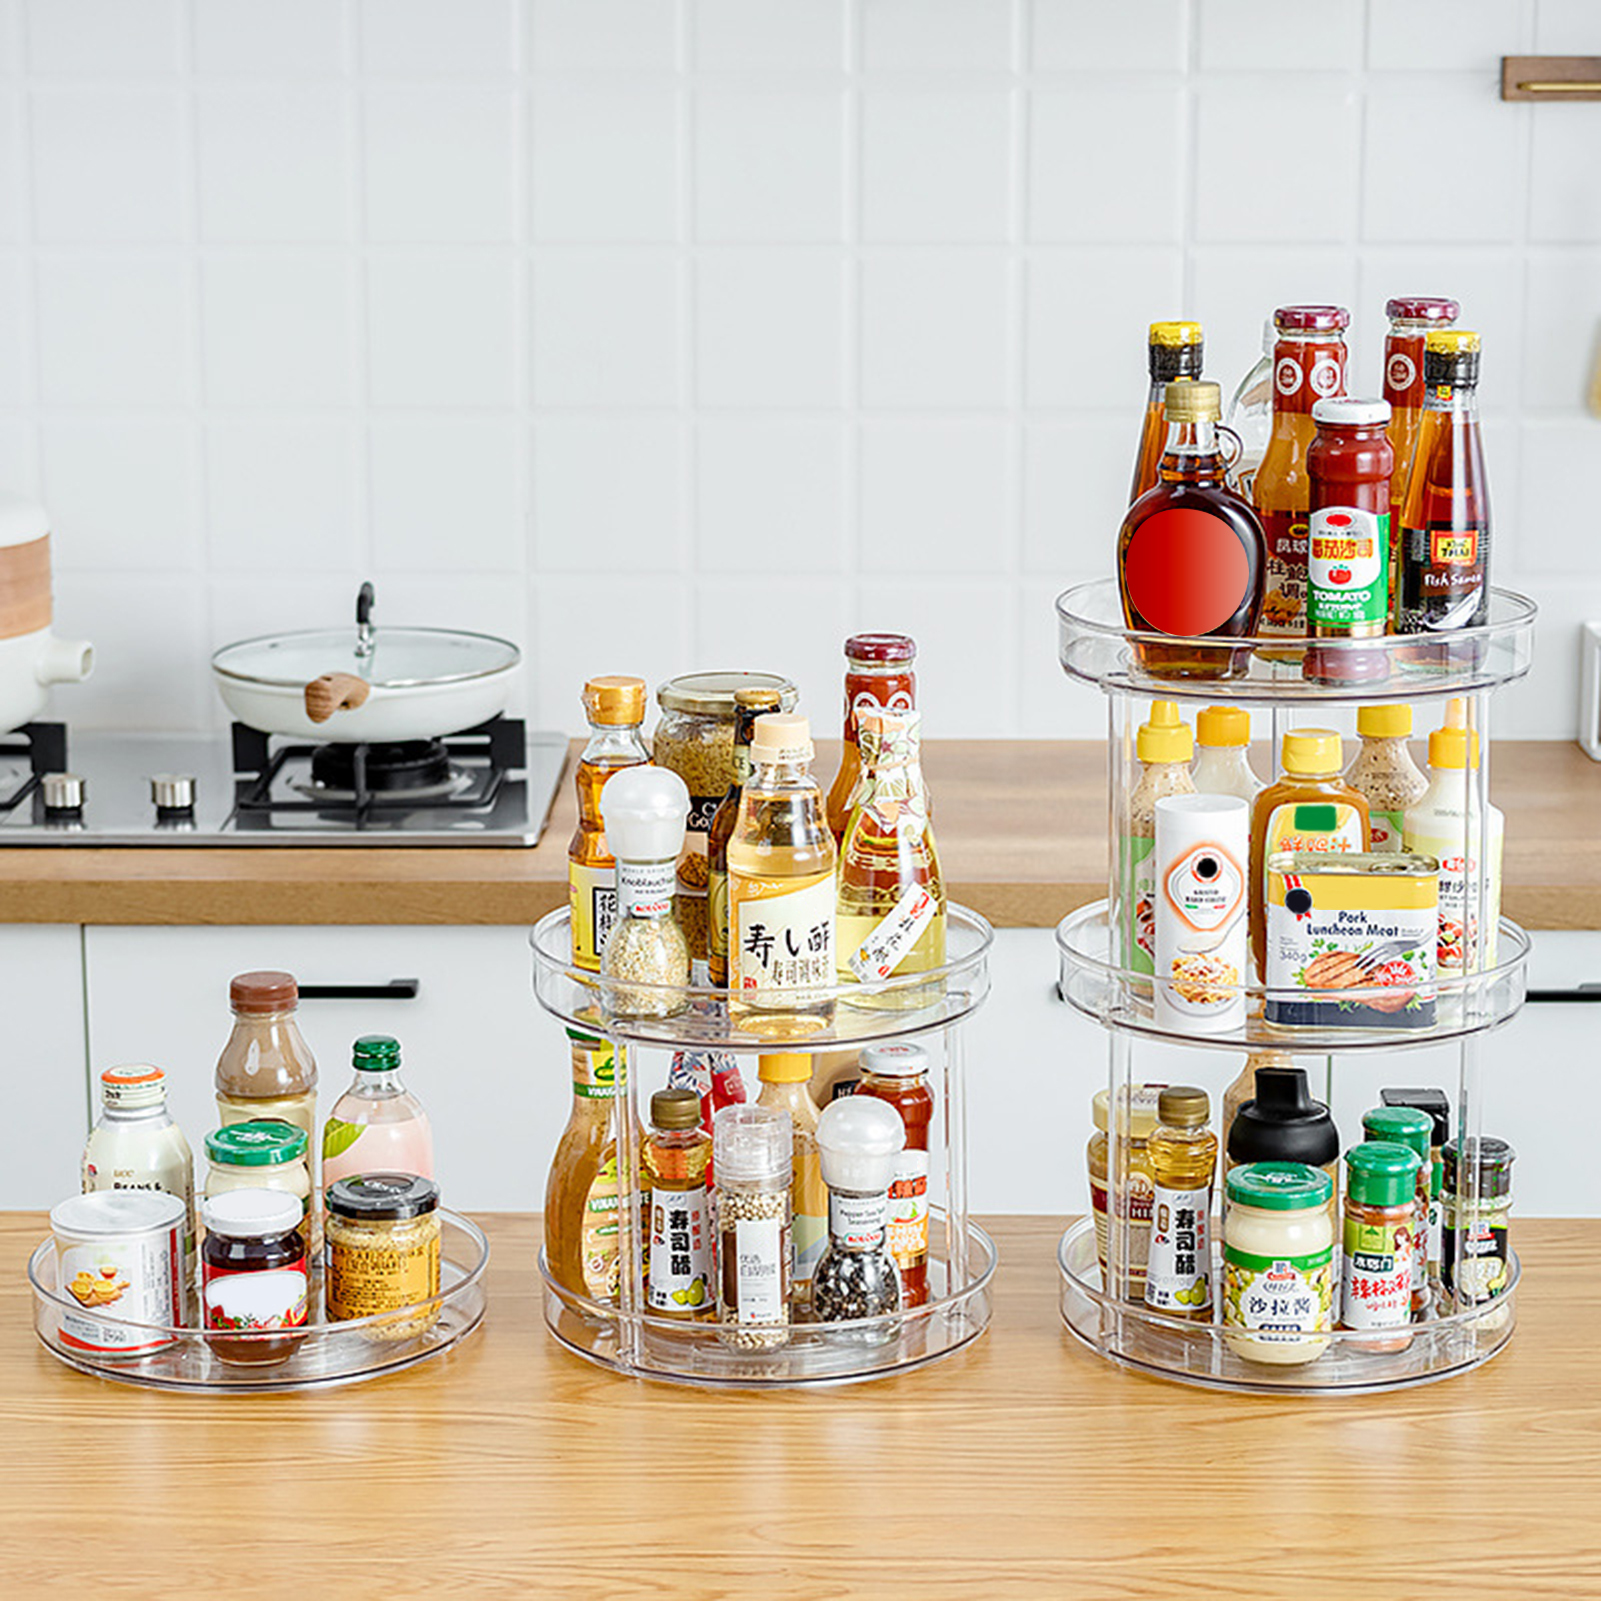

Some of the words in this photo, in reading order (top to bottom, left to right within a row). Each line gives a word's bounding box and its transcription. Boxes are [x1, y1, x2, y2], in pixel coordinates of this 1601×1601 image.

[1311, 537, 1374, 560] 番茄沙司
[1424, 573, 1449, 587] Fish
[1312, 590, 1372, 602] TOMATO
[1338, 911, 1368, 924] Pork
[1306, 923, 1363, 937] Luncheon
[1366, 924, 1399, 936] Meat
[669, 1209, 691, 1275] 寿司醋
[1175, 1208, 1196, 1275] 寿司醋
[1248, 1296, 1311, 1316] 沙拉酱
